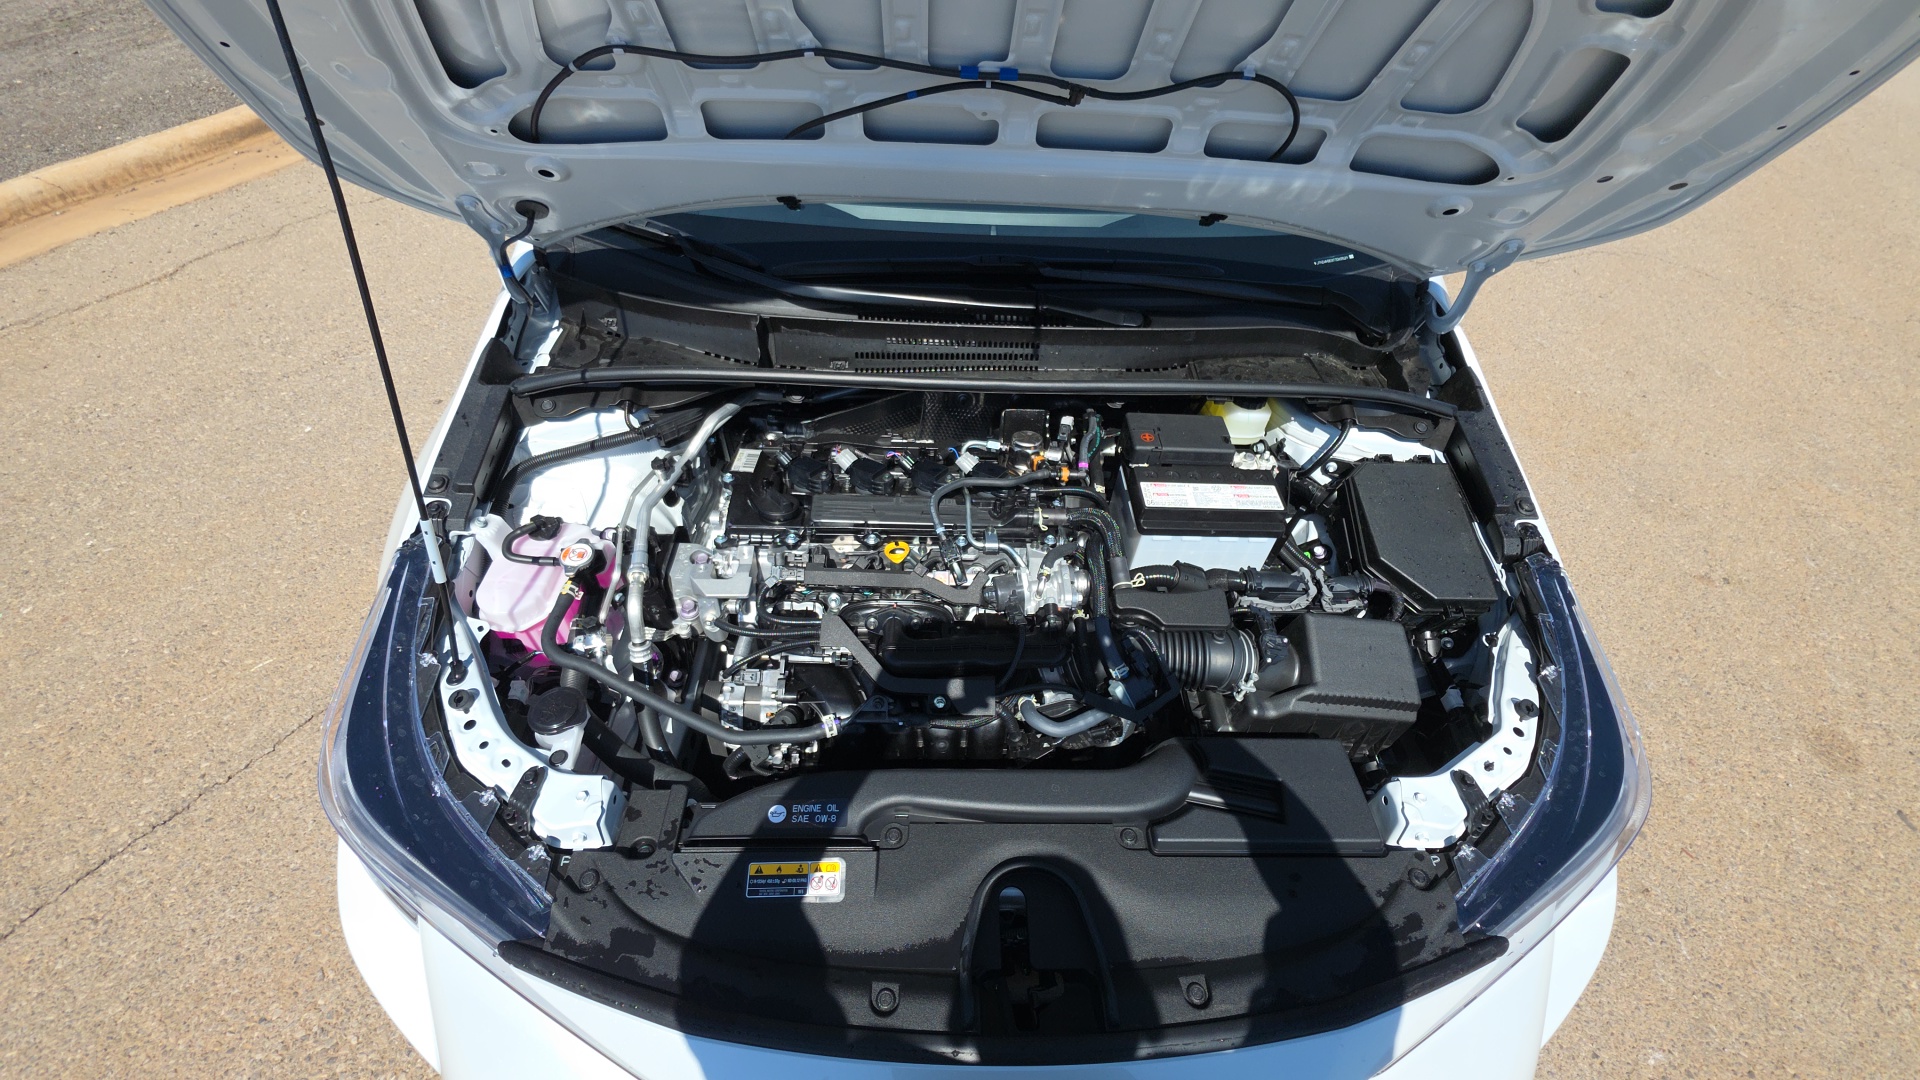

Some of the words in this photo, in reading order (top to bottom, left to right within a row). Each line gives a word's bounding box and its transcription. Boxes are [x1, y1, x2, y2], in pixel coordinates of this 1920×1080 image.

[792, 804, 822, 813] ENGINE
[826, 803, 840, 812] OIL
[791, 814, 810, 823] SAE
[815, 814, 837, 823] 0W-8
